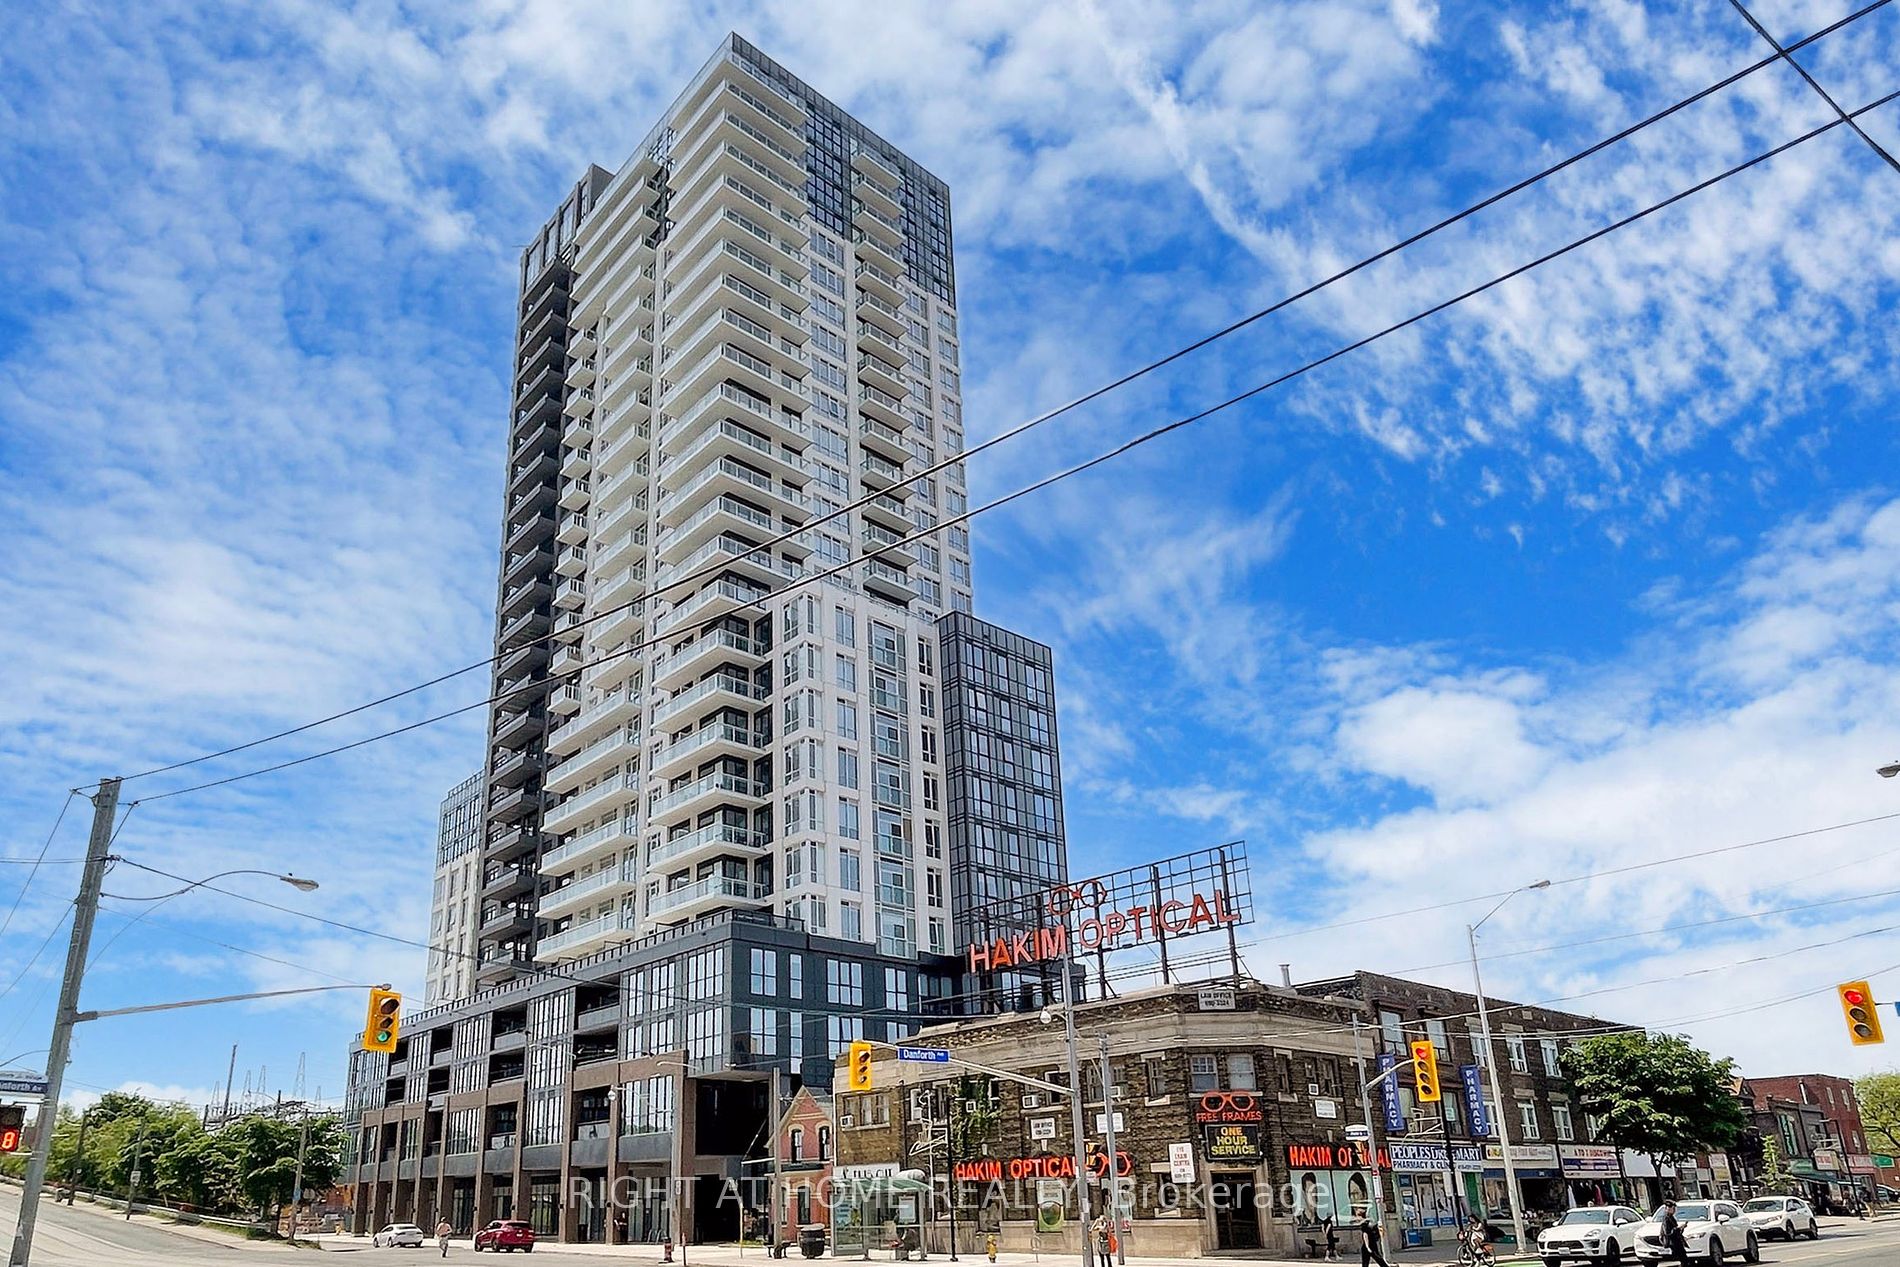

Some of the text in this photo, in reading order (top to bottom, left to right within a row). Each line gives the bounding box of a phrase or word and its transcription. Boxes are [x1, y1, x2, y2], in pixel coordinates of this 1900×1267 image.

[970, 889, 1241, 973] HAKIM OPTICAL
[903, 1049, 936, 1060] Danforth
[1382, 1058, 1398, 1127] PHARMACY
[1465, 1069, 1483, 1133] PHARMACY
[1196, 1110, 1263, 1123] FREE FRAMES
[1220, 1126, 1243, 1136] ONE
[2, 1131, 16, 1149] 8
[1216, 1135, 1248, 1146] HOUR
[1211, 1145, 1256, 1156] SERVICE
[1289, 1145, 1332, 1167] HAKIM
[1391, 1145, 1431, 1159] PEOPLES
[955, 1161, 1002, 1181] HAKIM
[1393, 1160, 1428, 1169] PHARMACY
[1430, 1160, 1435, 1169] &
